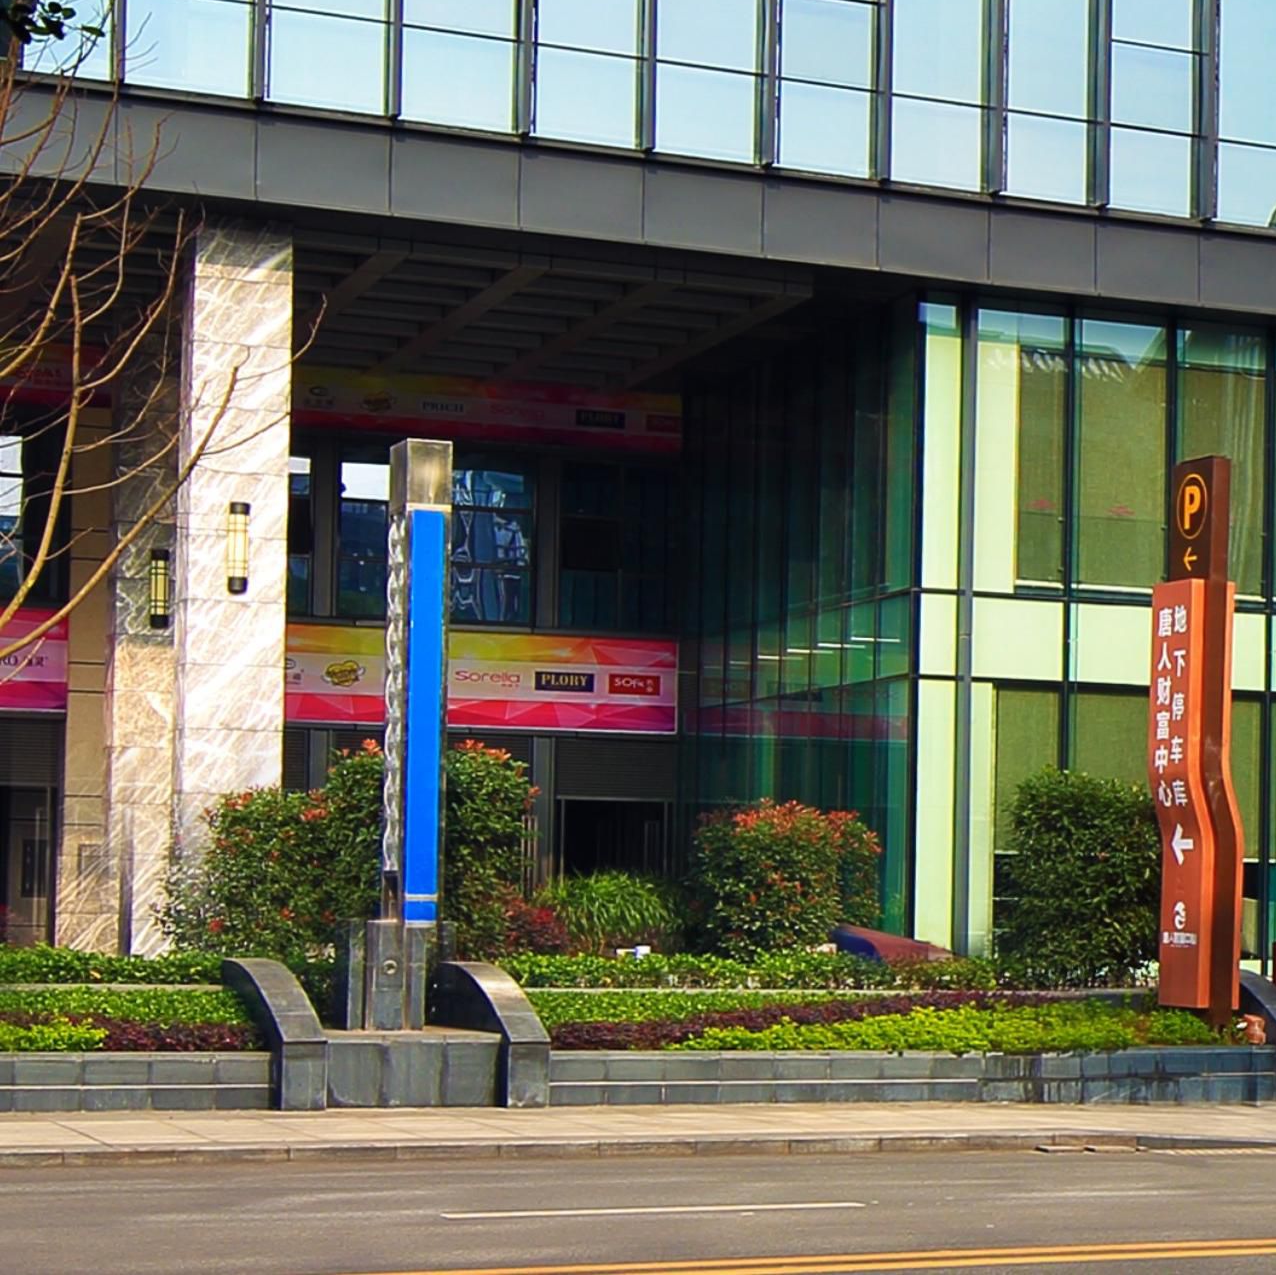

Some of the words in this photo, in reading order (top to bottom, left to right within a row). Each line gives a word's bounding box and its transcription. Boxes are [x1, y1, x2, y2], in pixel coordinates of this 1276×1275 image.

[1183, 484, 1202, 530] P
[455, 670, 521, 684] Sorella
[541, 672, 588, 687] PLORY
[1154, 608, 1173, 808] 唐人财富中心
[1170, 605, 1188, 807] 地下停车库
